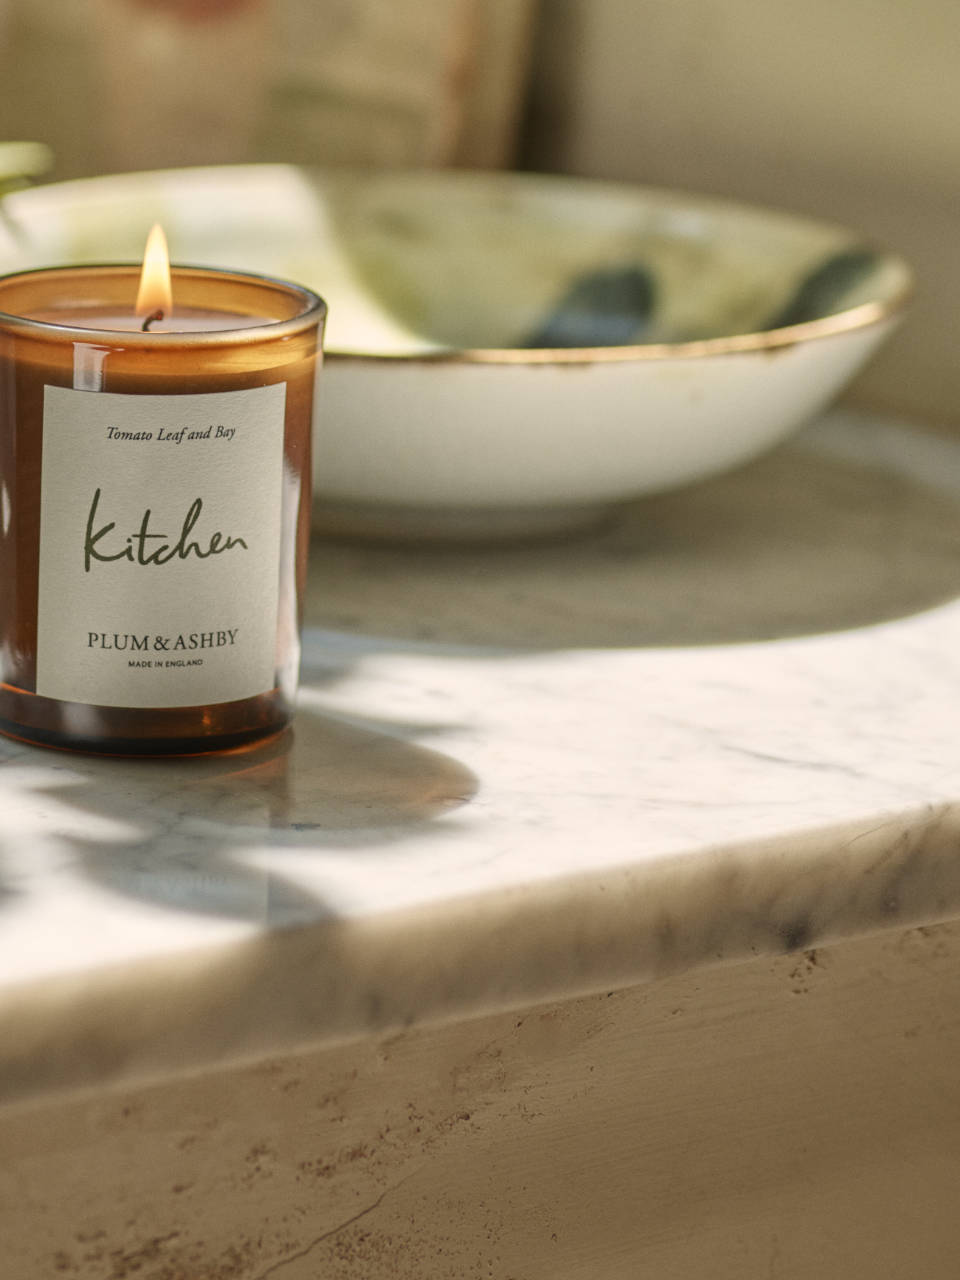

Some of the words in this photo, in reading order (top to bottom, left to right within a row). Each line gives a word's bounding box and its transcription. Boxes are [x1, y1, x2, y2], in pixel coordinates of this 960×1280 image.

[106, 426, 153, 441] Tomato
[156, 426, 189, 445] Leaf
[187, 425, 213, 440] and
[214, 425, 236, 441] Bay
[128, 660, 152, 668] MADE
[154, 660, 163, 668] IN
[165, 658, 204, 668] ENGLAND
